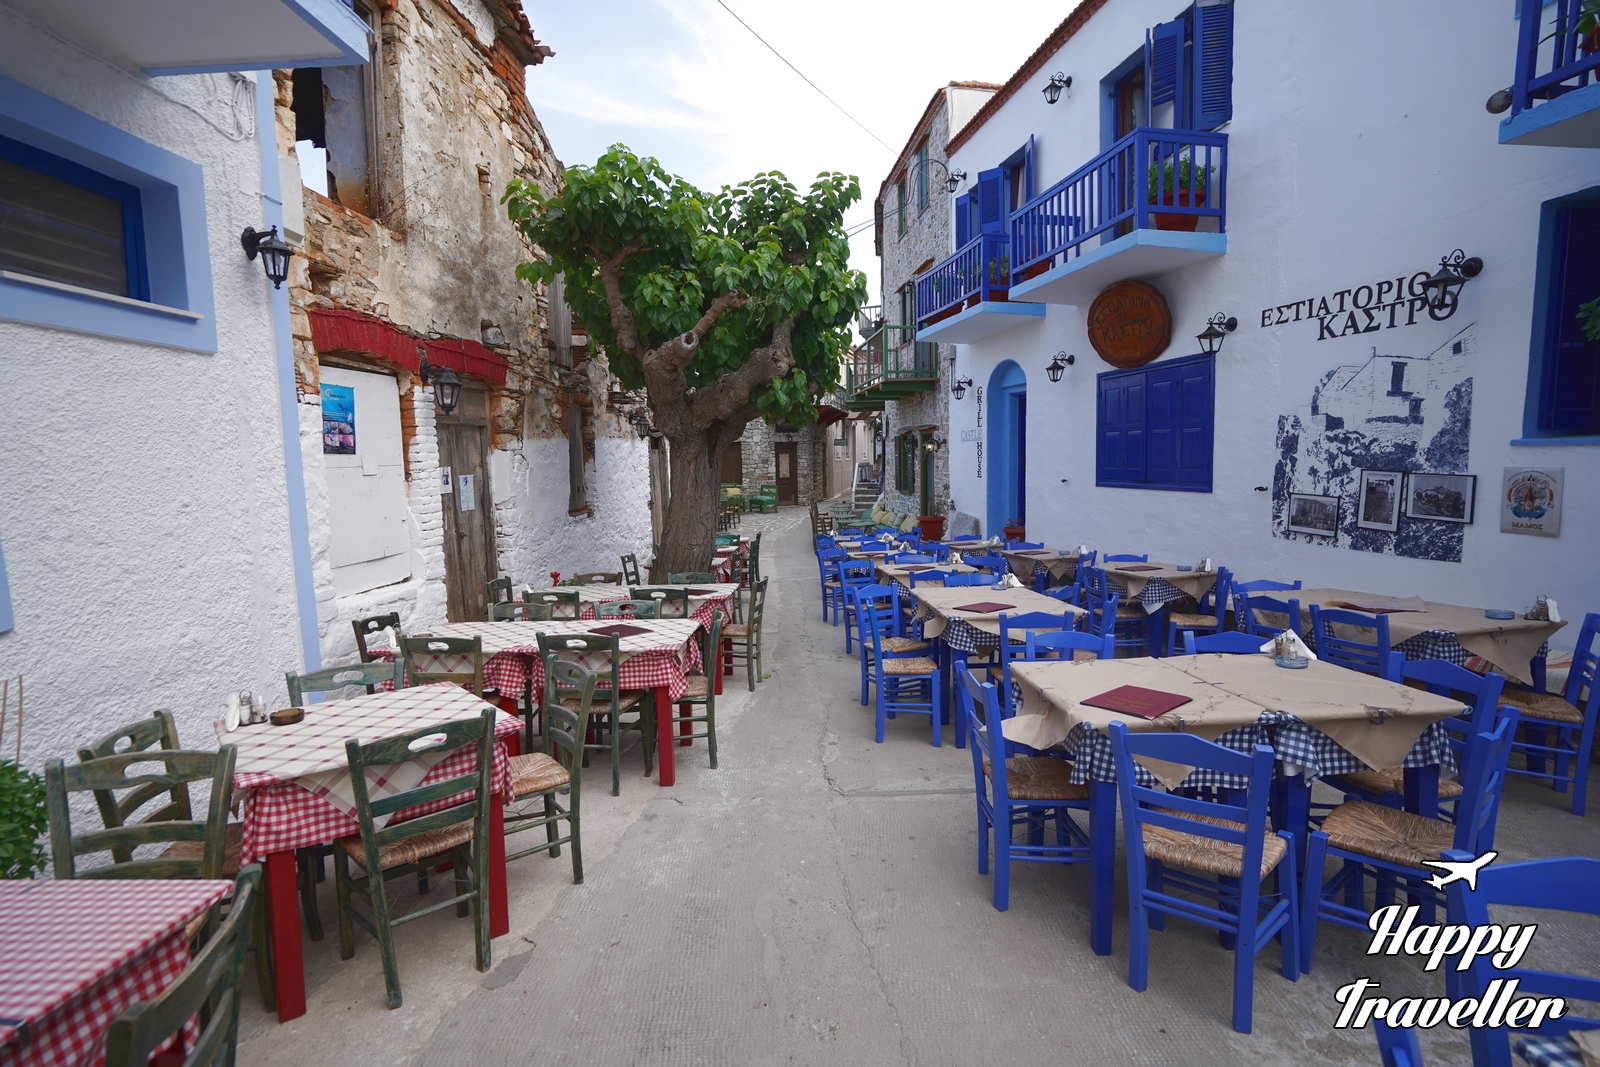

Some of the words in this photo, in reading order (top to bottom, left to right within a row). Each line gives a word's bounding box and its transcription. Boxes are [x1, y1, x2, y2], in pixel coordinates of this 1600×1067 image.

[1261, 271, 1432, 328] ΕΣΤΙΑΤΟΡΙΟ
[1317, 290, 1458, 341] ΚΑΣΤΡΟ
[1101, 315, 1152, 344] ΚΑΣΤΡΟ
[960, 429, 983, 441] CASTLE
